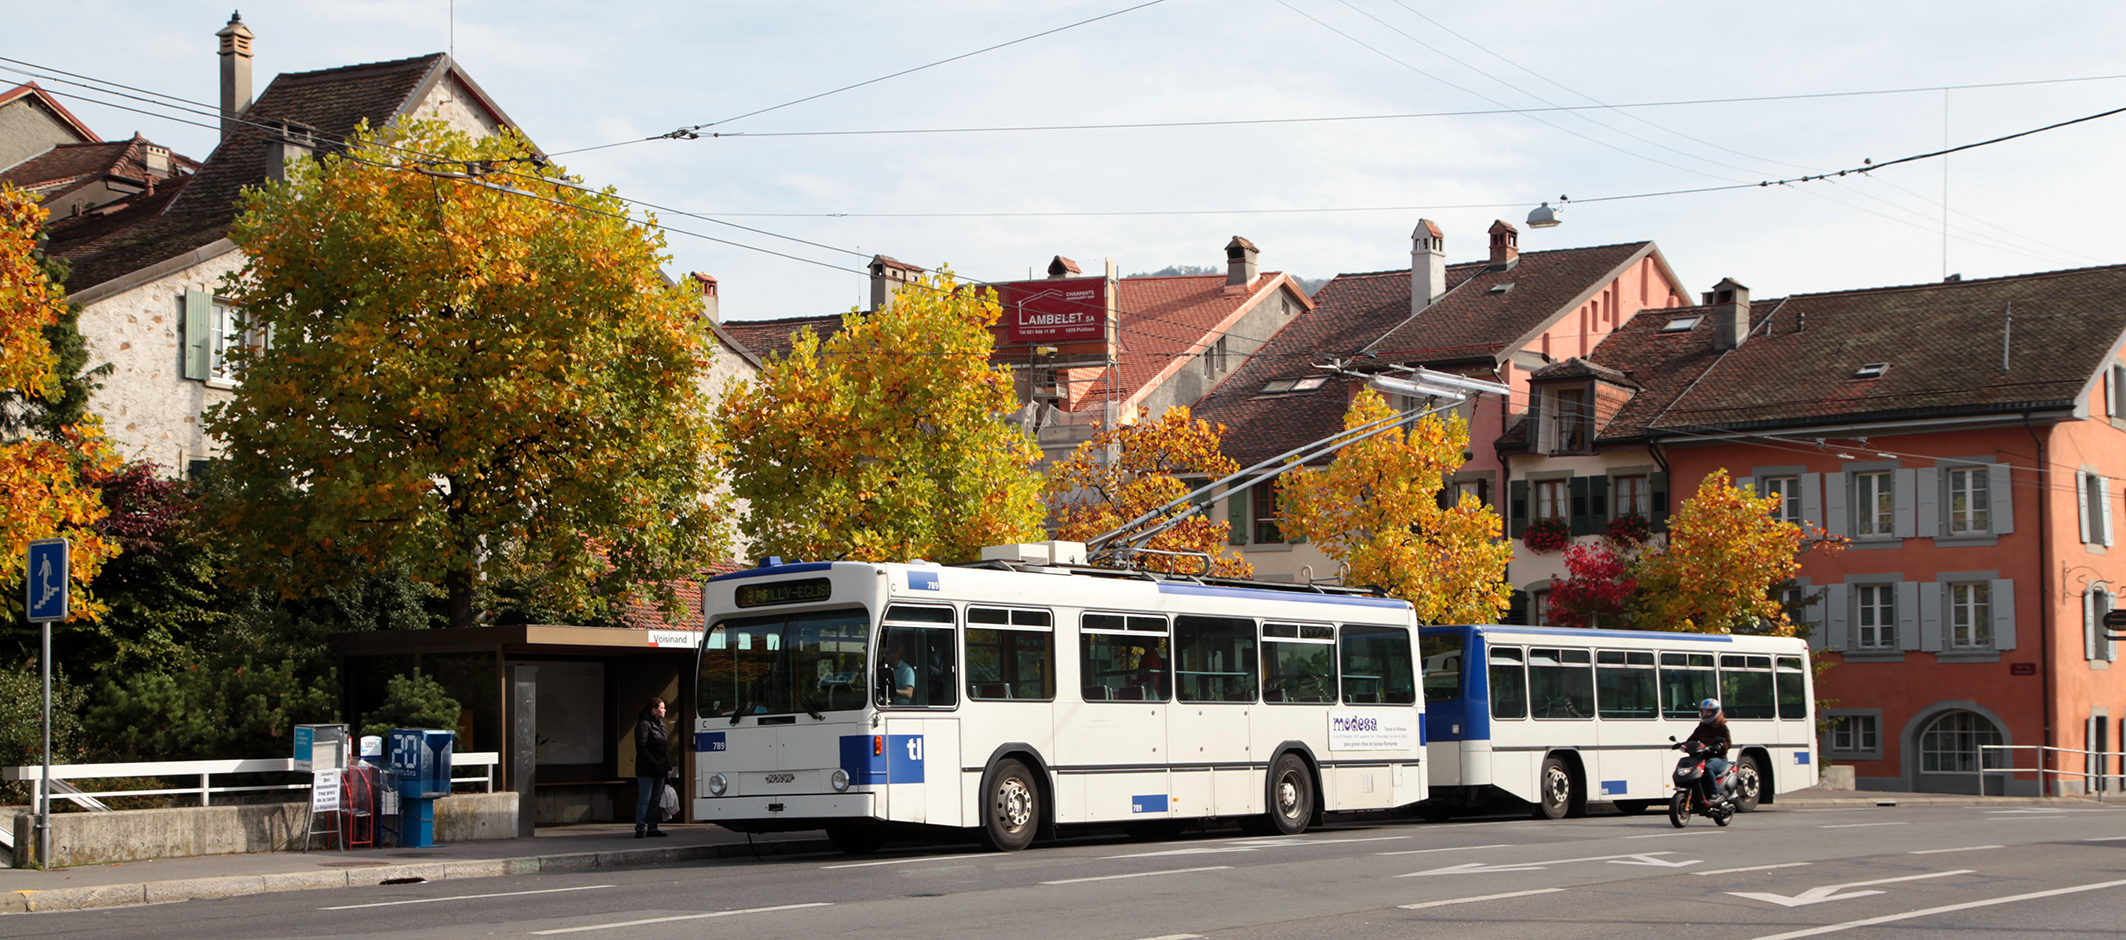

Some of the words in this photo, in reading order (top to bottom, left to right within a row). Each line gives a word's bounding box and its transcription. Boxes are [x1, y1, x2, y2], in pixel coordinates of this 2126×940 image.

[1018, 301, 1083, 325] LAMBELET
[891, 583, 896, 592] C
[927, 581, 939, 590] 789
[654, 634, 687, 644] Voisinand
[1333, 715, 1378, 732] modesa
[392, 734, 417, 769] 20
[712, 742, 725, 750] 789
[906, 738, 922, 760] tl
